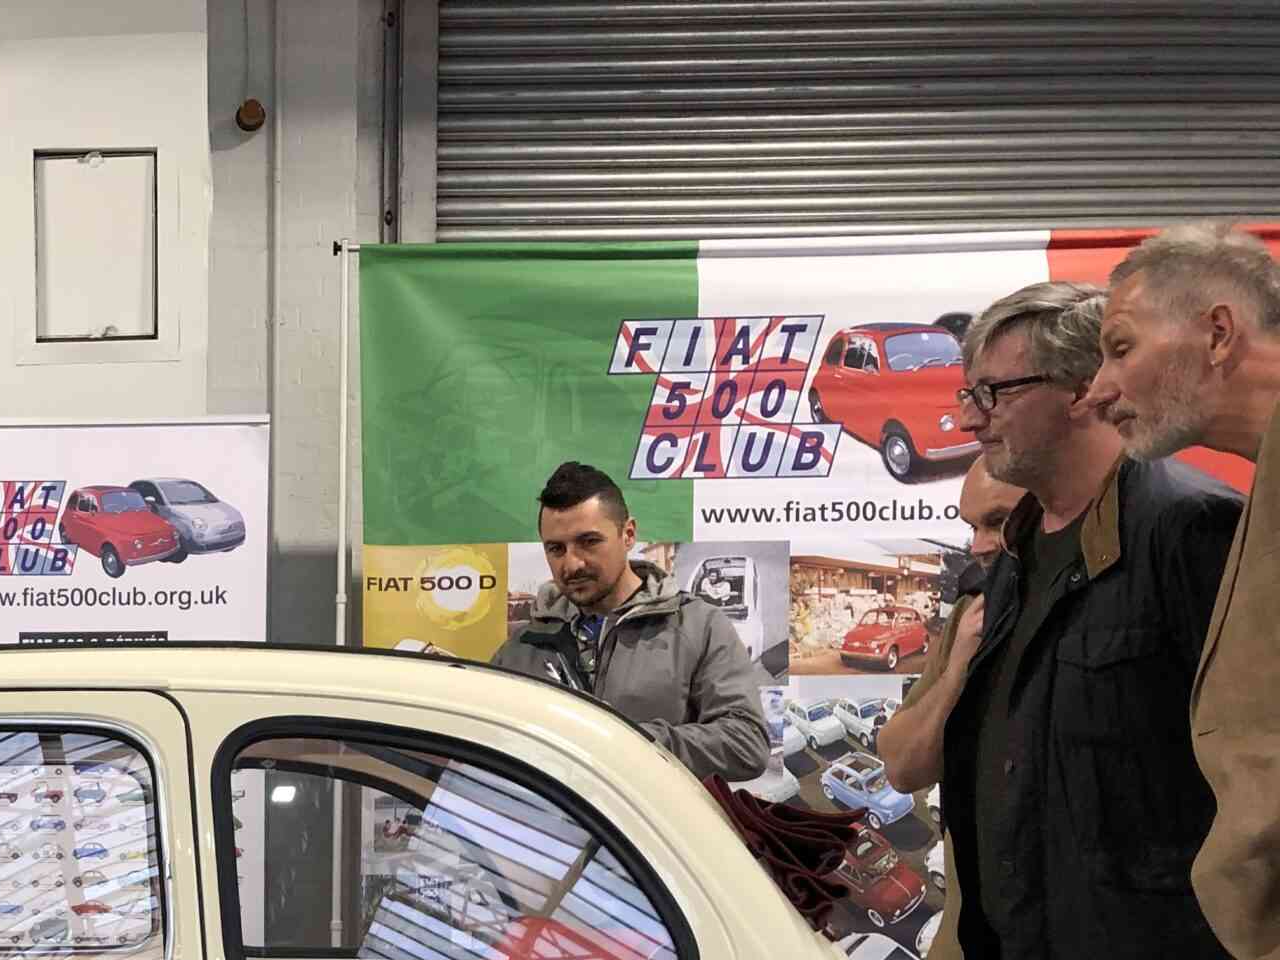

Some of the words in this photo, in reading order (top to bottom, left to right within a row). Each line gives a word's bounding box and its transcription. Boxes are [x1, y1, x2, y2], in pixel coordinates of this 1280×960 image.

[624, 324, 808, 368] FIAT
[662, 378, 787, 420] 500
[646, 431, 825, 474] CLUB
[701, 499, 960, 524] www.fiat500club.o
[367, 576, 414, 592] FIAT
[420, 575, 473, 592] 500
[479, 574, 497, 590] D
